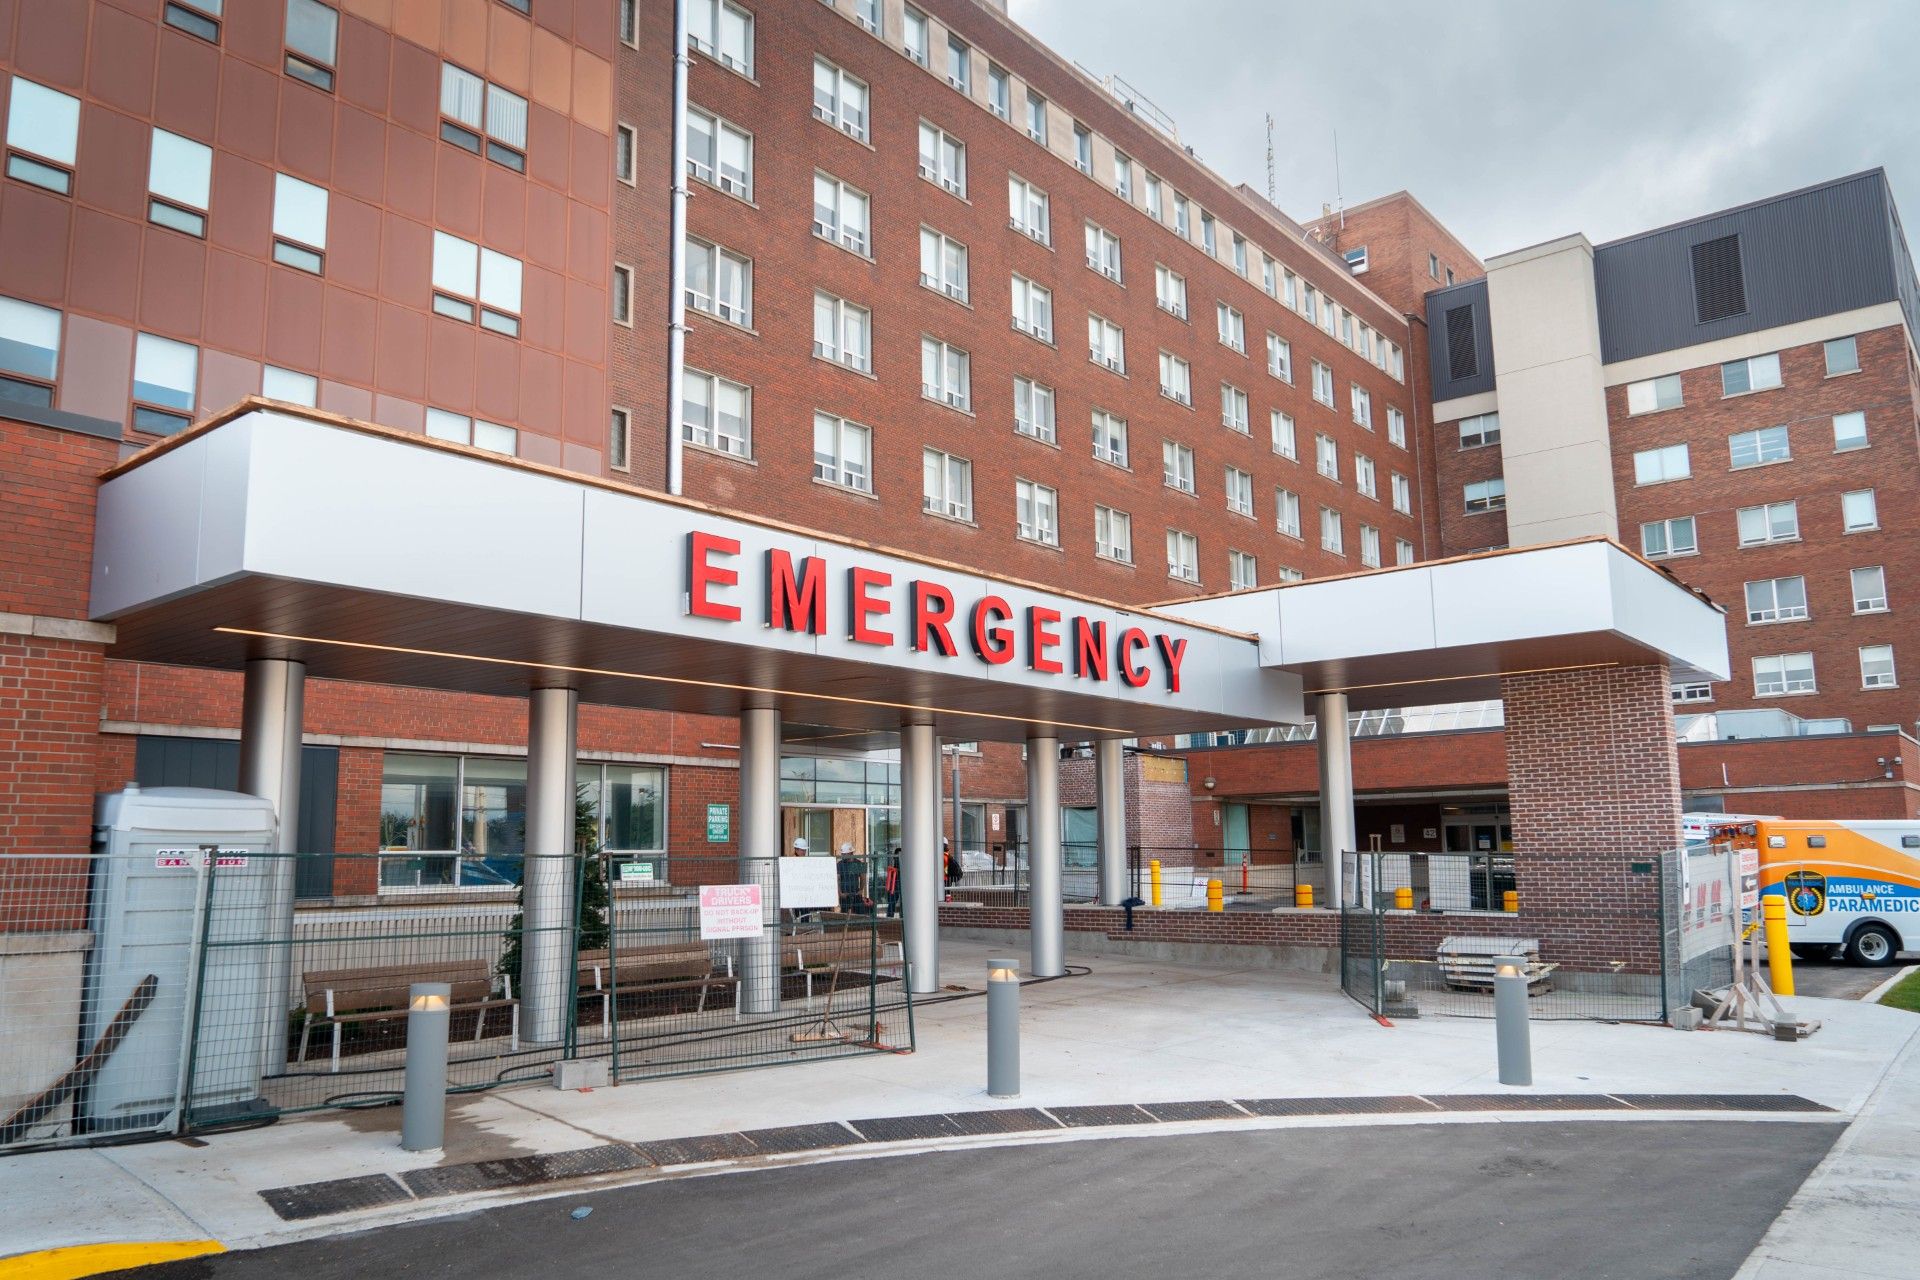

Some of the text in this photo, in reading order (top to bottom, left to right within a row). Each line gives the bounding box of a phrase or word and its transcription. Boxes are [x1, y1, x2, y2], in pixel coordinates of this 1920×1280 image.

[685, 530, 1188, 693] EMERGENCY
[709, 807, 728, 816] PRIVATE
[708, 815, 728, 823] PARKING
[716, 887, 751, 897] TRUCK
[1828, 884, 1894, 894] AMBULANCE
[711, 896, 752, 906] DRIVERS
[1829, 898, 1920, 912] PARAMEDIC
